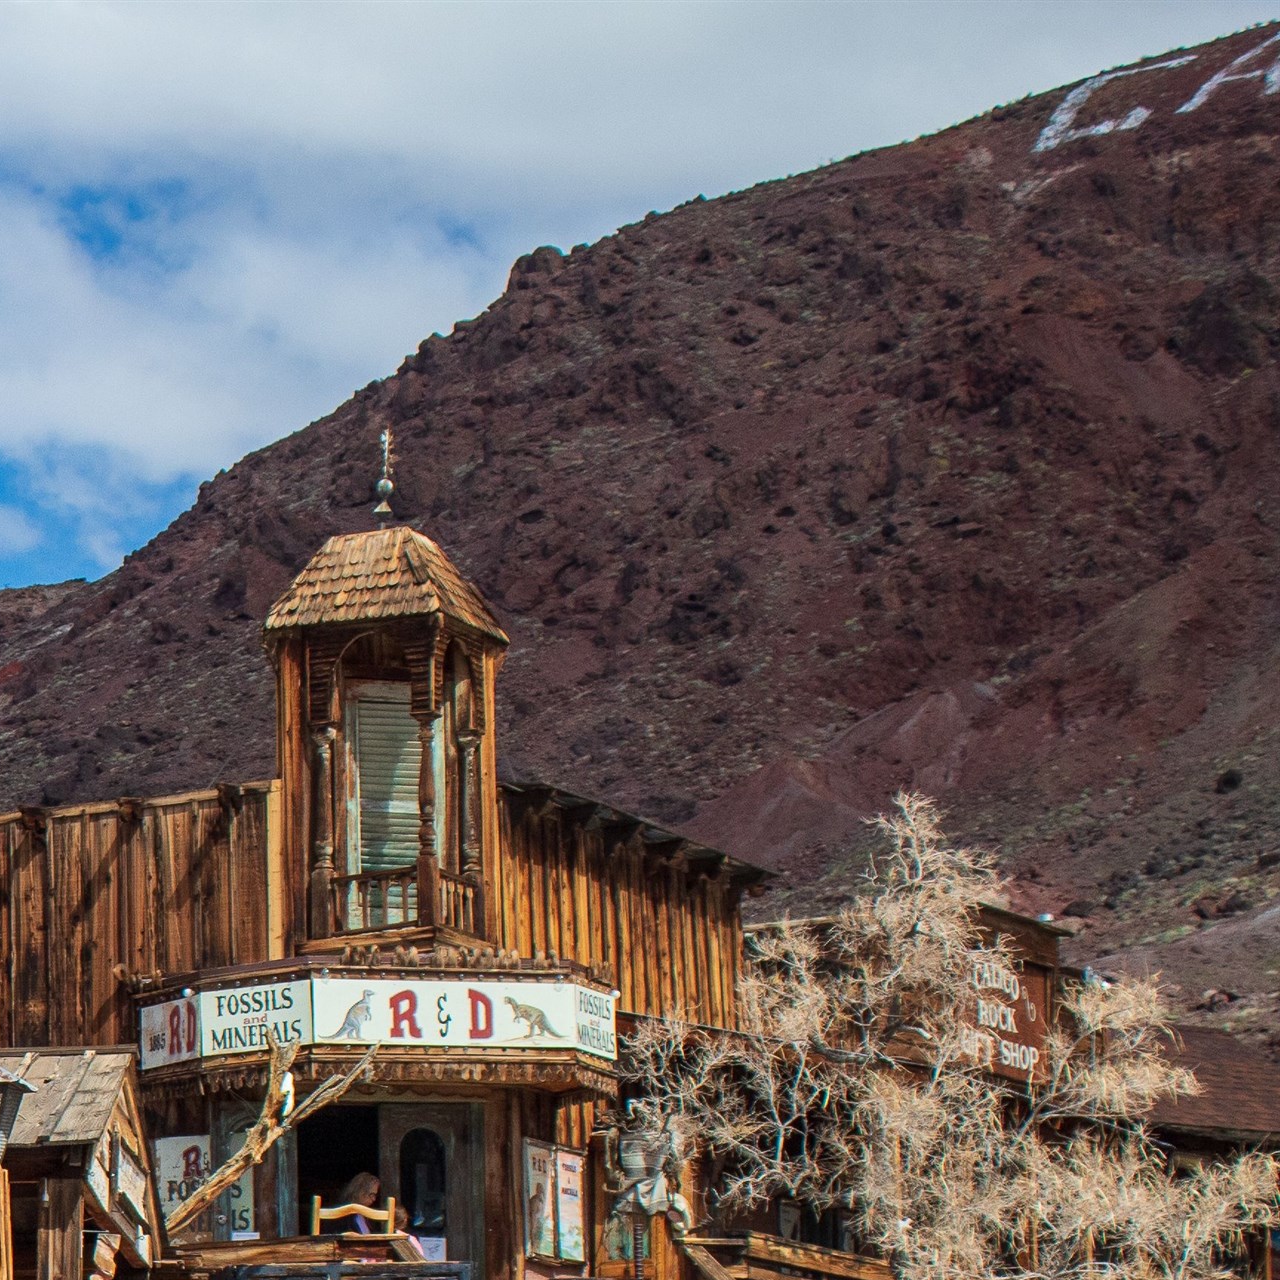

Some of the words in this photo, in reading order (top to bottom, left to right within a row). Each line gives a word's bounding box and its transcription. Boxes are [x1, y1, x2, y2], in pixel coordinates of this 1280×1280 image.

[216, 987, 294, 1017] FOSSILS
[389, 989, 422, 1039] R
[468, 988, 494, 1039] D
[578, 990, 611, 1021] FOSSILS
[977, 998, 1019, 1034] ROCK
[186, 1000, 197, 1053] D
[211, 1018, 303, 1051] MINERALS
[243, 1013, 268, 1025] and
[589, 1018, 601, 1028] and
[577, 1022, 615, 1053] MINERALS
[1000, 1039, 1040, 1072] SHOP
[182, 1144, 202, 1179] R
